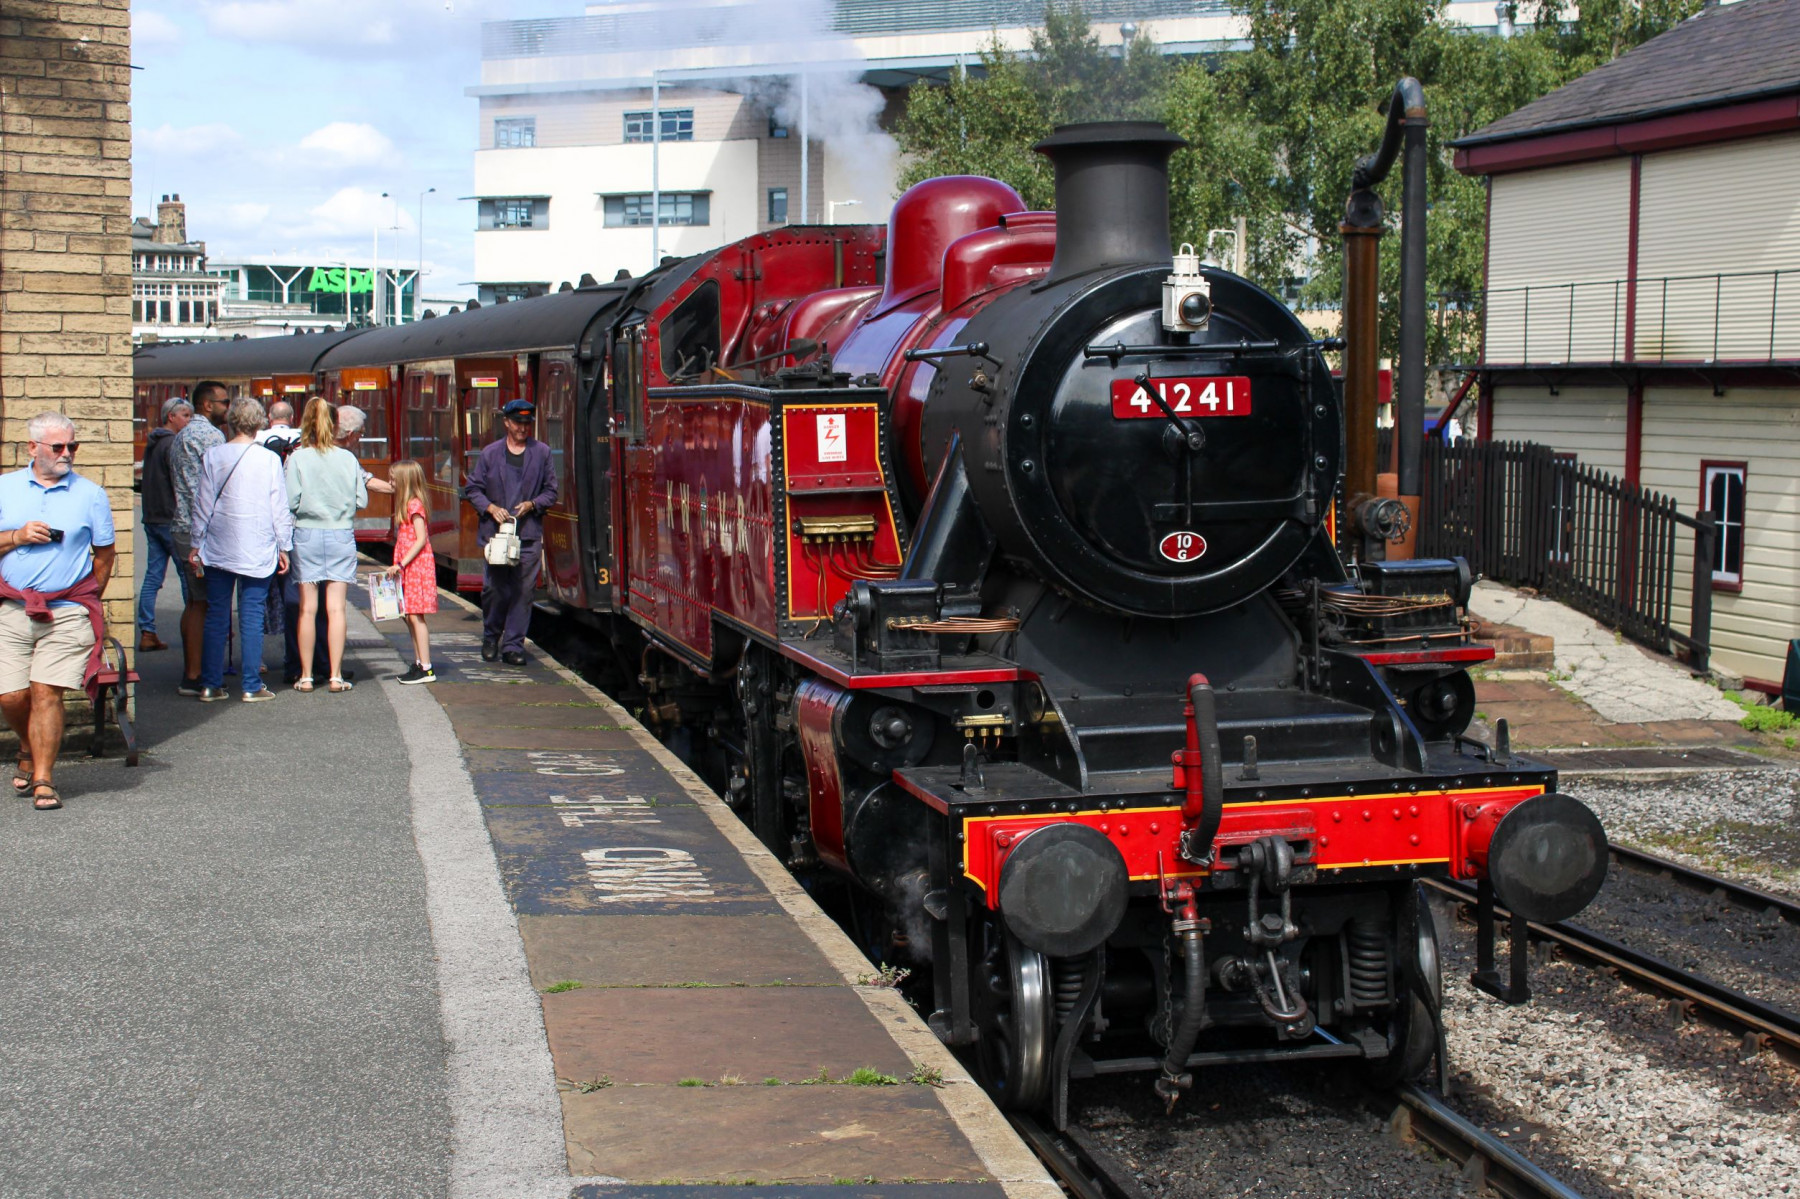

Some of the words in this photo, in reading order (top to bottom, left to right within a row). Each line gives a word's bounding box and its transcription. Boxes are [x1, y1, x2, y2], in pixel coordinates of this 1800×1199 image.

[308, 268, 374, 294] ASDA
[1130, 382, 1234, 413] 41241
[1177, 534, 1192, 549] 10
[1177, 549, 1187, 560] G
[549, 794, 662, 828] THE
[581, 847, 715, 903] MIND
